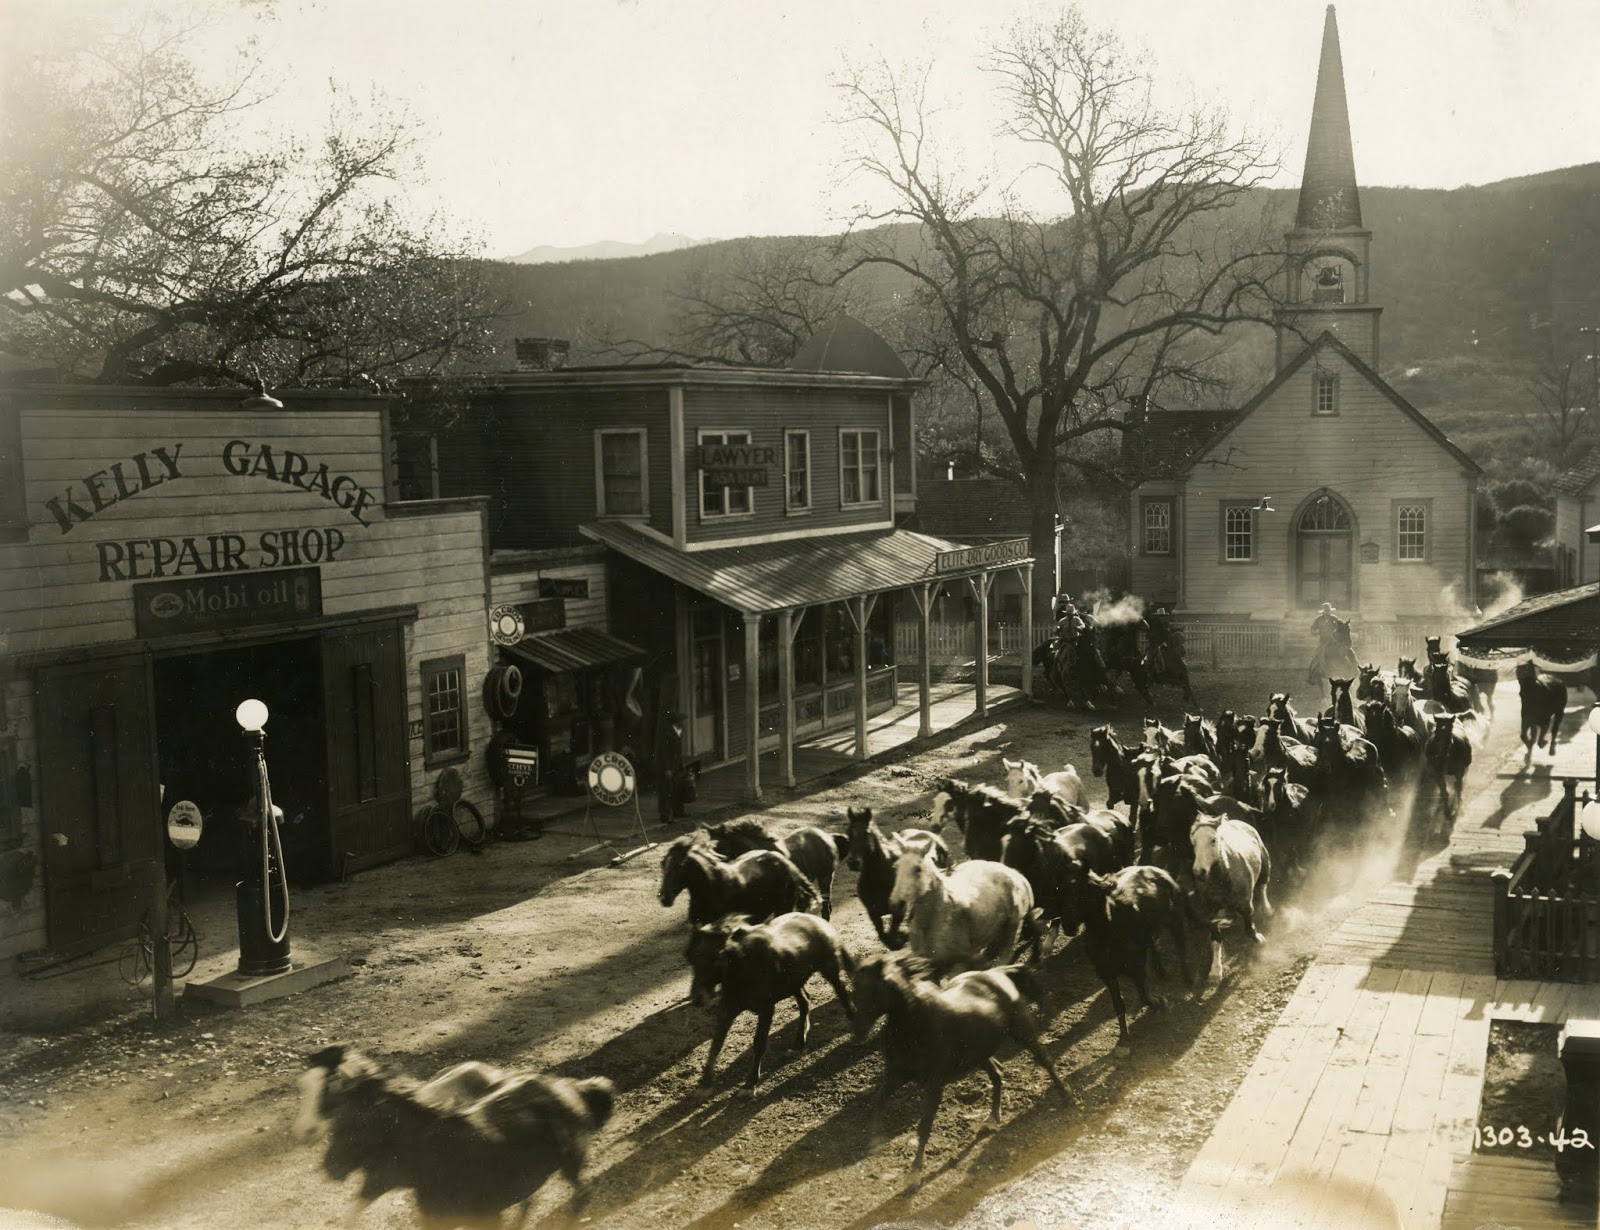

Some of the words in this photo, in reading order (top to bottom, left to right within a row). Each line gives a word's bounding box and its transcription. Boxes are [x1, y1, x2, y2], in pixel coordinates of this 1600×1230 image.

[702, 447, 775, 465] LAWYER
[45, 443, 183, 534] KELLY
[223, 440, 375, 527] GARAGE
[96, 534, 247, 581] REPAIR
[259, 528, 345, 568] SHOP
[942, 552, 965, 569] ELITE
[967, 549, 982, 565] DRY
[984, 544, 1013, 561] GOODS
[492, 611, 500, 623] ED
[501, 606, 523, 623] CROW
[495, 632, 522, 644] GASOLINE
[590, 759, 602, 773] ED
[604, 754, 632, 777] CROW
[593, 785, 632, 804] GASOLINE
